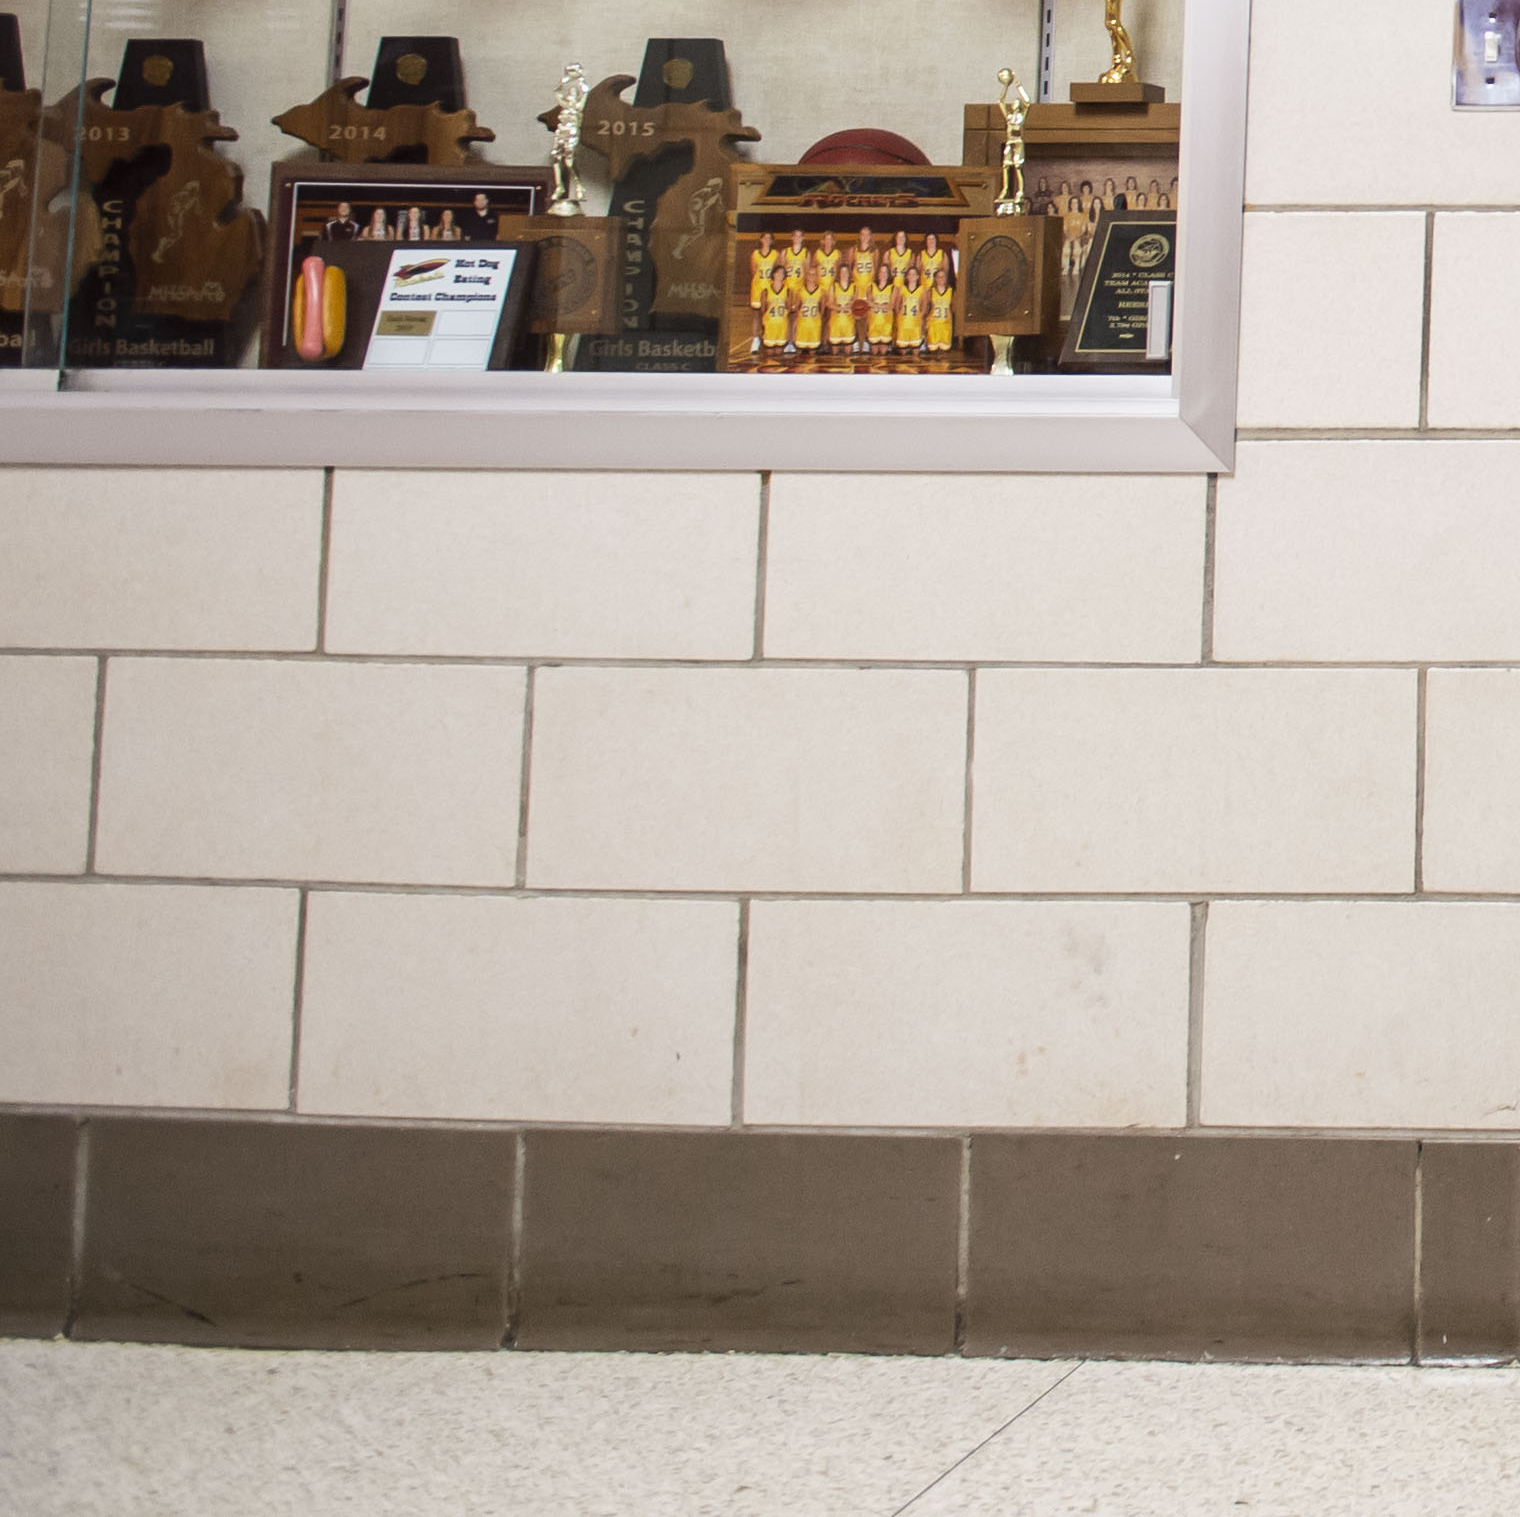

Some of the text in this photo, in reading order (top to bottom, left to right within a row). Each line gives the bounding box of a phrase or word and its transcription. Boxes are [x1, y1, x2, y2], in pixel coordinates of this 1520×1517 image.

[328, 125, 387, 141] 2014
[597, 120, 655, 137] 2015
[95, 199, 125, 329] CHAMPION
[478, 259, 500, 270] Dog
[453, 275, 492, 286] Eating
[389, 292, 497, 303] Contest Champions
[115, 338, 214, 357] Basketball
[589, 340, 716, 358] Girls Basketb
